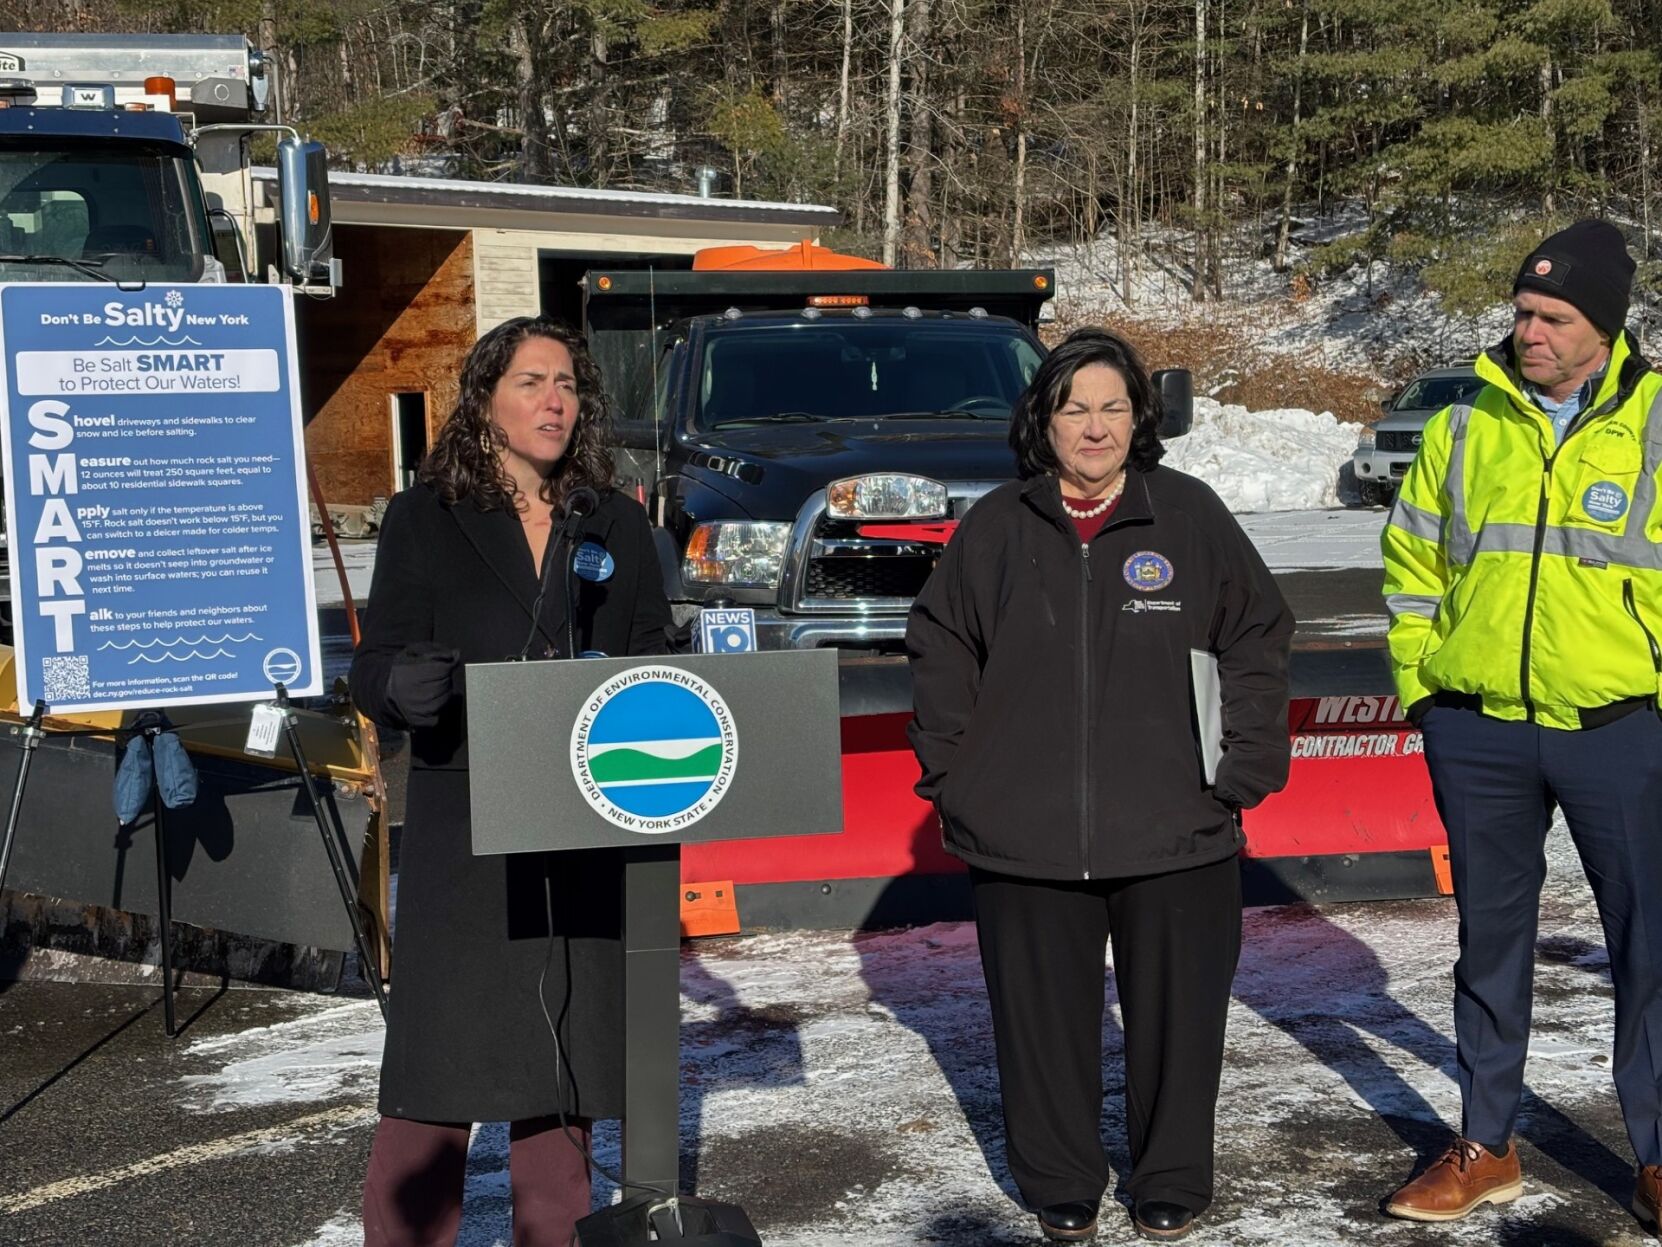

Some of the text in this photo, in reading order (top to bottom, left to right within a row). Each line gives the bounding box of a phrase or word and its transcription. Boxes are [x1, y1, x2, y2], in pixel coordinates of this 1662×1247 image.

[83, 313, 101, 324] Be
[104, 302, 184, 332] Salty
[186, 314, 216, 325] New
[219, 314, 249, 325] York
[73, 354, 224, 373] Be Salt SMART
[59, 378, 76, 392] to
[81, 376, 141, 391] Protect
[145, 375, 176, 390] Our
[117, 418, 161, 427] driveways
[181, 416, 223, 424] sidewalks
[224, 416, 234, 424] to
[102, 429, 119, 437] and
[120, 429, 134, 437] ice
[135, 428, 164, 436] before
[133, 458, 148, 466] out
[196, 456, 214, 464] rock
[234, 456, 250, 464] you
[81, 470, 91, 479] 12
[126, 469, 141, 477] will
[143, 469, 164, 477] treat
[166, 467, 184, 476] 250
[185, 468, 214, 476] square
[237, 466, 261, 475] equal
[81, 482, 107, 490] about
[109, 480, 120, 489] 10
[121, 480, 166, 489] residential
[168, 479, 206, 487] sidewalk
[1590, 491, 1622, 508] Salty
[112, 508, 127, 516] salt
[130, 507, 148, 516] only
[150, 506, 155, 514] if
[157, 506, 172, 514] the
[173, 505, 226, 514] temperature
[104, 518, 126, 526] Rock
[128, 518, 144, 527] salt
[179, 516, 200, 524] work
[202, 516, 229, 524] below
[251, 514, 266, 522] but
[267, 514, 283, 522] you
[86, 532, 103, 540] can
[104, 530, 133, 539] switch
[134, 530, 144, 538] to
[153, 528, 180, 537] deicer
[182, 527, 207, 535] made
[222, 526, 249, 534] colder
[138, 550, 154, 558] and
[156, 549, 185, 557] collect
[221, 546, 236, 554] salt
[238, 545, 257, 553] after
[87, 563, 112, 571] melts
[126, 562, 132, 570] it
[168, 560, 189, 568] seep
[191, 558, 208, 566] into
[209, 557, 264, 567] groundwater
[265, 556, 274, 564] or
[89, 574, 113, 582] wash
[115, 573, 132, 581] into
[134, 572, 166, 581] surface
[201, 570, 217, 579] you
[219, 569, 235, 577] can
[236, 568, 260, 576] reuse
[262, 566, 268, 574] it
[92, 586, 111, 594] next
[126, 612, 145, 620] your
[148, 609, 178, 617] friends
[180, 608, 196, 616] and
[198, 606, 241, 615] neighbors
[242, 604, 267, 612] about
[705, 612, 750, 624] NEWS
[90, 624, 115, 632] these
[117, 623, 141, 631] steps
[142, 622, 152, 630] to
[154, 620, 173, 629] help
[175, 619, 206, 628] protect
[710, 626, 749, 654] 10
[92, 680, 105, 688] For
[191, 674, 204, 682] the
[204, 673, 217, 681] QR
[576, 670, 734, 800] DEPARTMENT OF ENVIRONMENTAL CONSERVATION
[1291, 734, 1398, 758] CONTRACTOR
[608, 804, 708, 829] NEW YORK STATE
